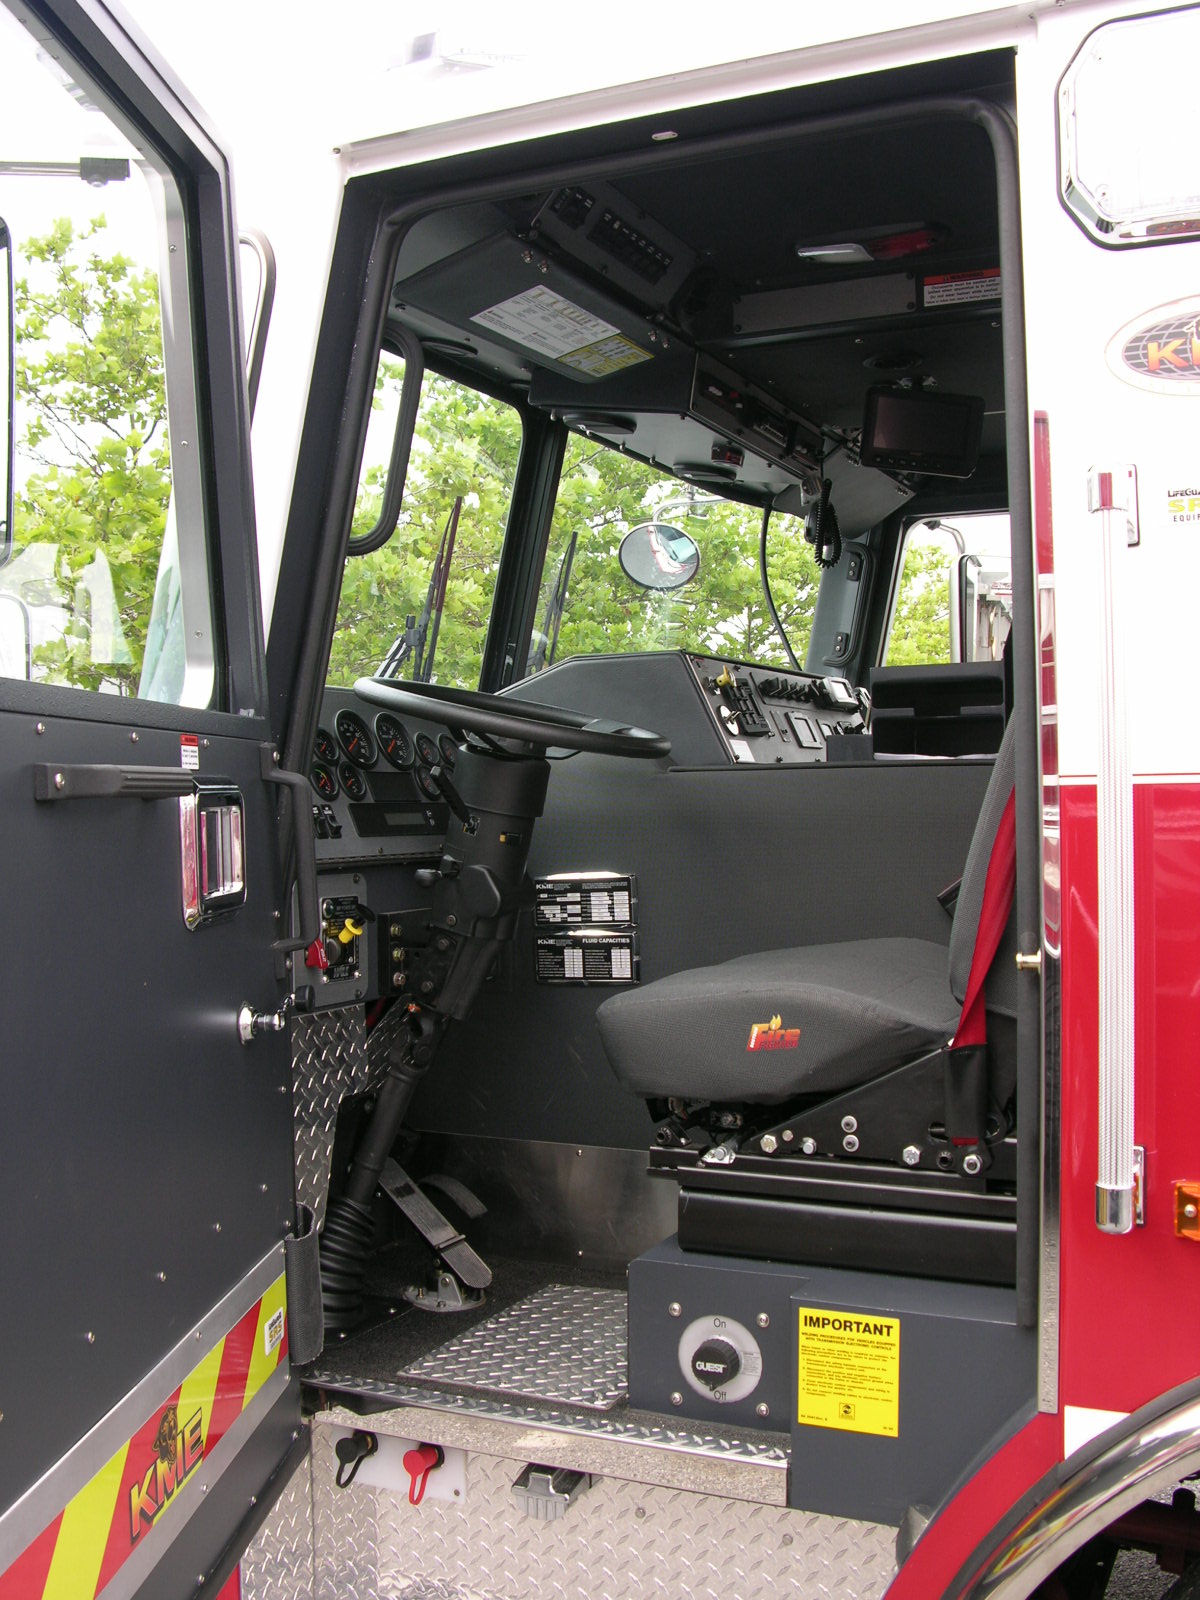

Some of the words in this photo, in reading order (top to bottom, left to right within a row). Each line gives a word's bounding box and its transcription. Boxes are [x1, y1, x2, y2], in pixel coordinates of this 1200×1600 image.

[1147, 338, 1200, 371] K
[713, 1317, 727, 1329] On
[804, 1315, 893, 1337] IMPORTANT
[695, 1361, 727, 1374] GUEST
[713, 1390, 727, 1401] Off
[130, 1407, 203, 1545] KME
